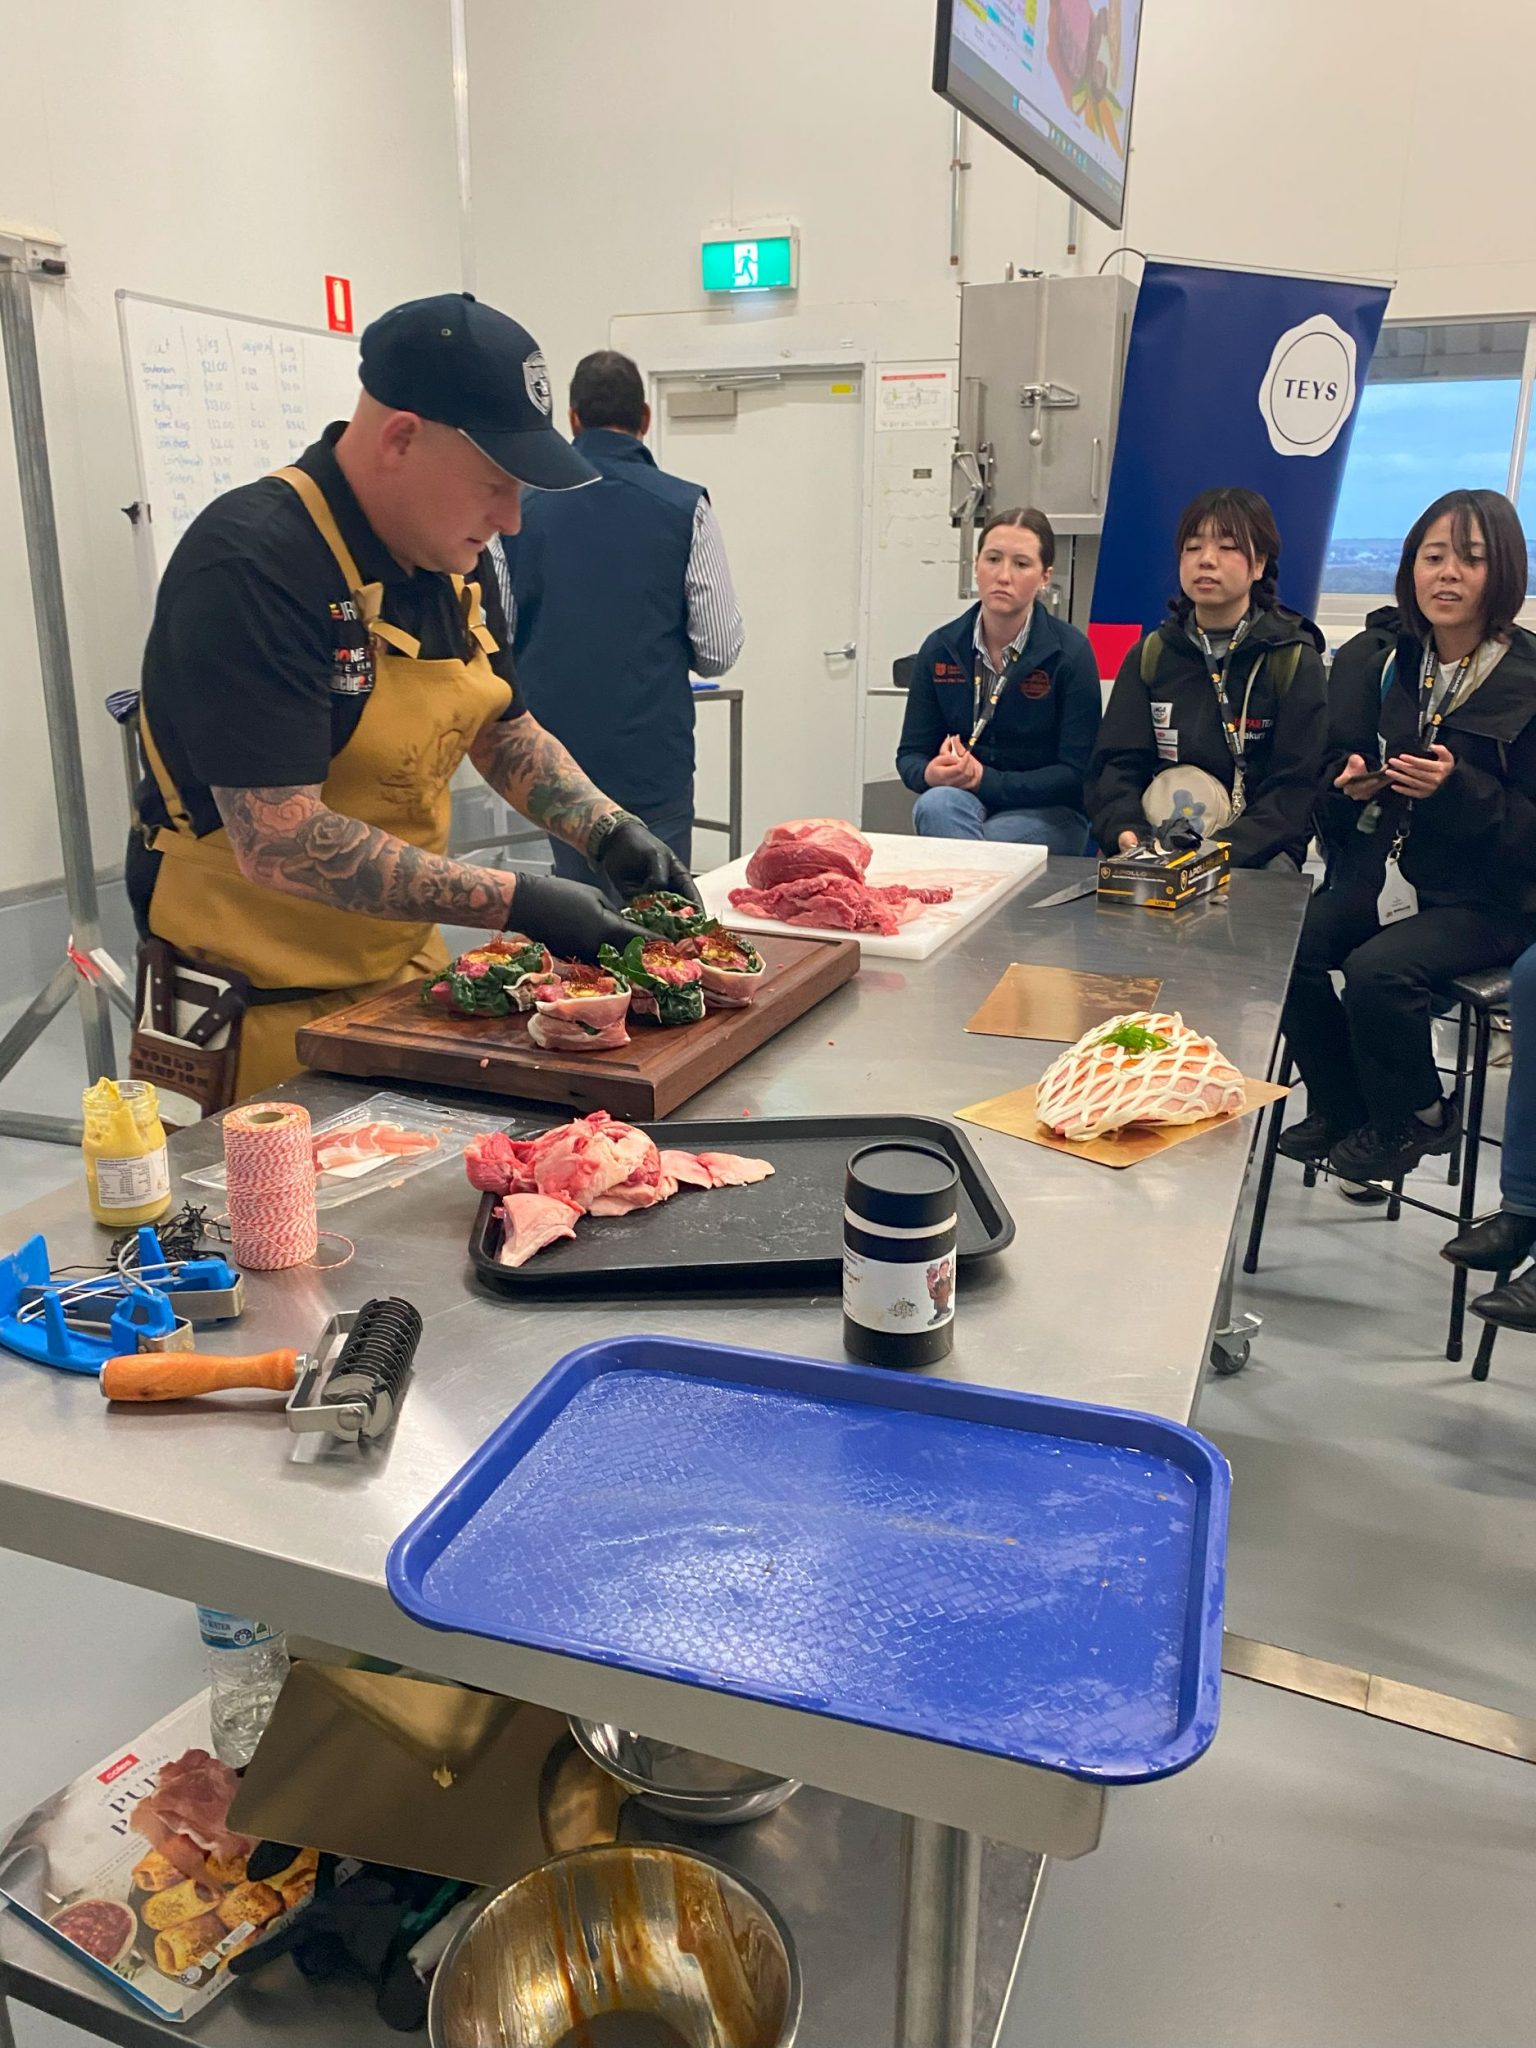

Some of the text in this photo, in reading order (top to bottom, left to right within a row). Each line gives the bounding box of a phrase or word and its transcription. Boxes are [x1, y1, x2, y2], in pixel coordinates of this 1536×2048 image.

[1284, 379, 1338, 401] TEYS
[139, 1047, 195, 1073] WORLD
[208, 1620, 231, 1631] WATER
[106, 1759, 133, 1779] coles
